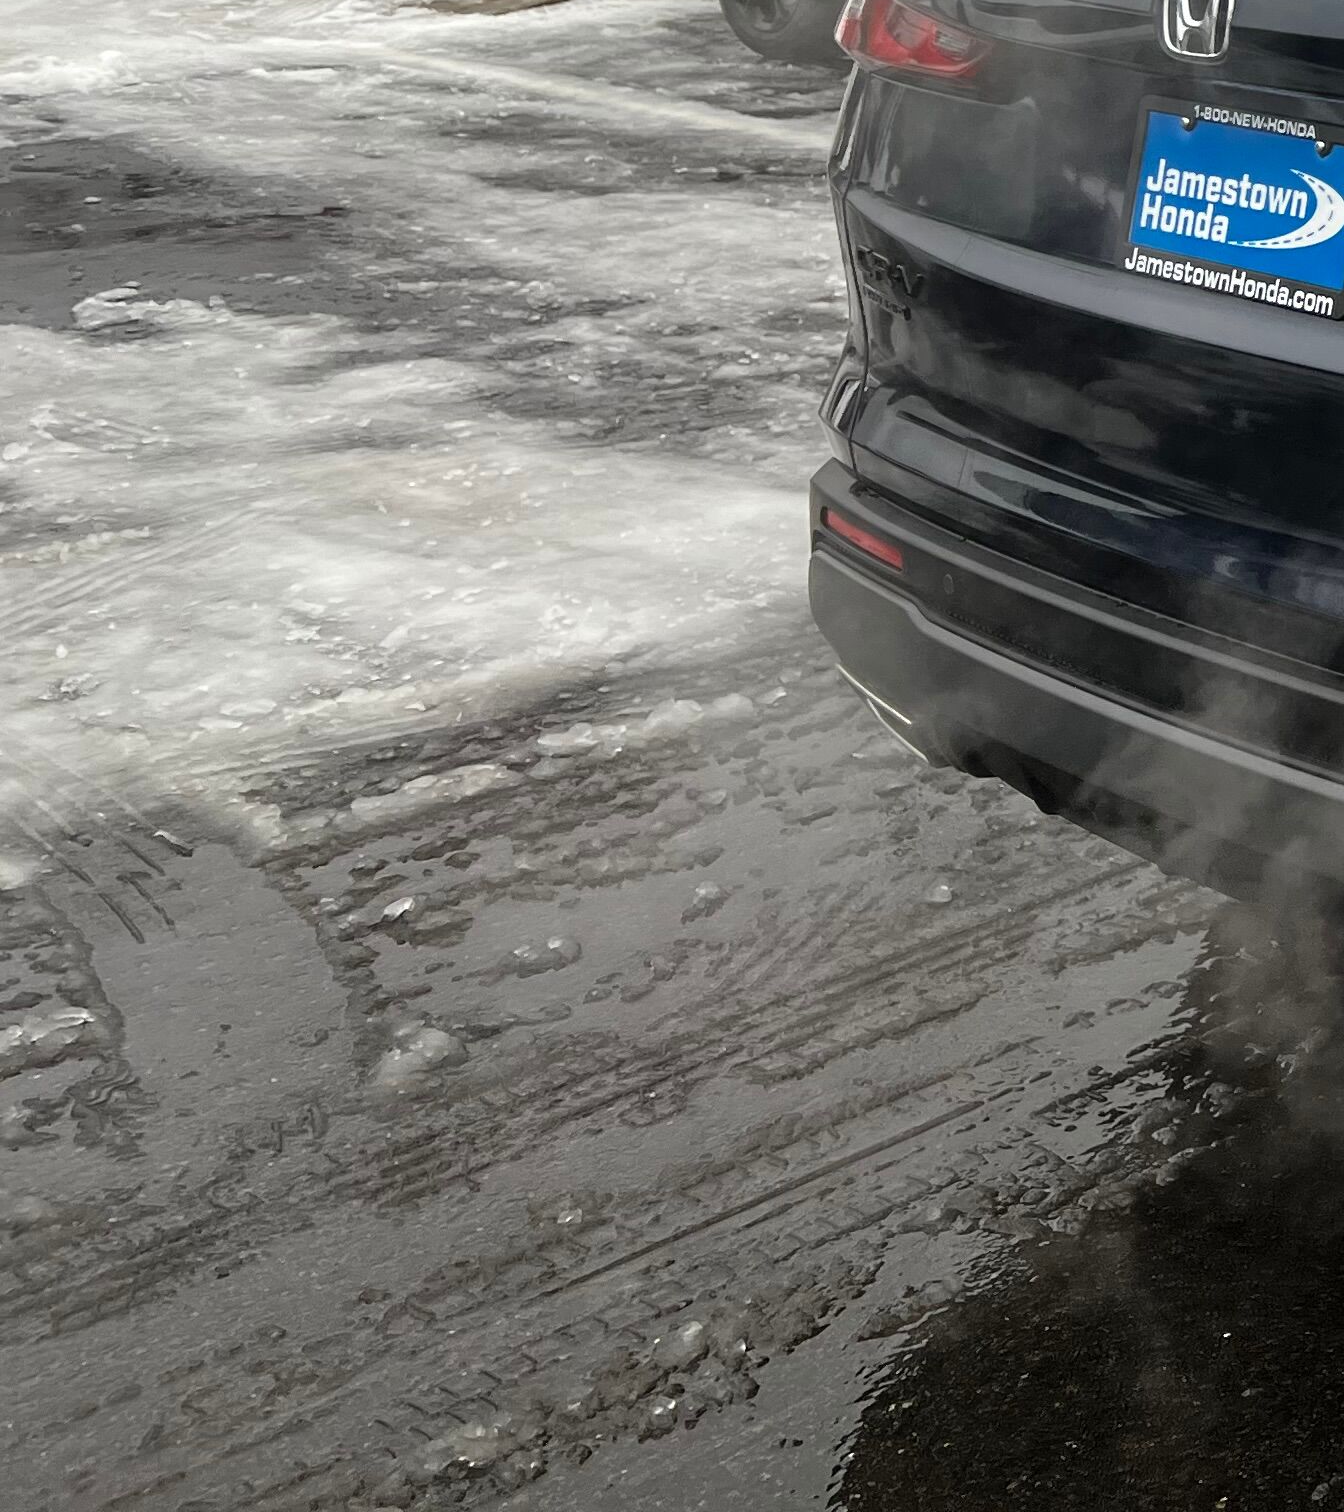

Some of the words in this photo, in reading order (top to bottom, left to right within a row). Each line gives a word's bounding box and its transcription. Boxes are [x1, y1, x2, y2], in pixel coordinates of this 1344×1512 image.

[1194, 104, 1316, 139] 1-800-NEW-HONDA
[1146, 159, 1308, 219] Jamestown
[1140, 193, 1230, 244] Honda
[1124, 247, 1335, 317] JamestownHonda.com
